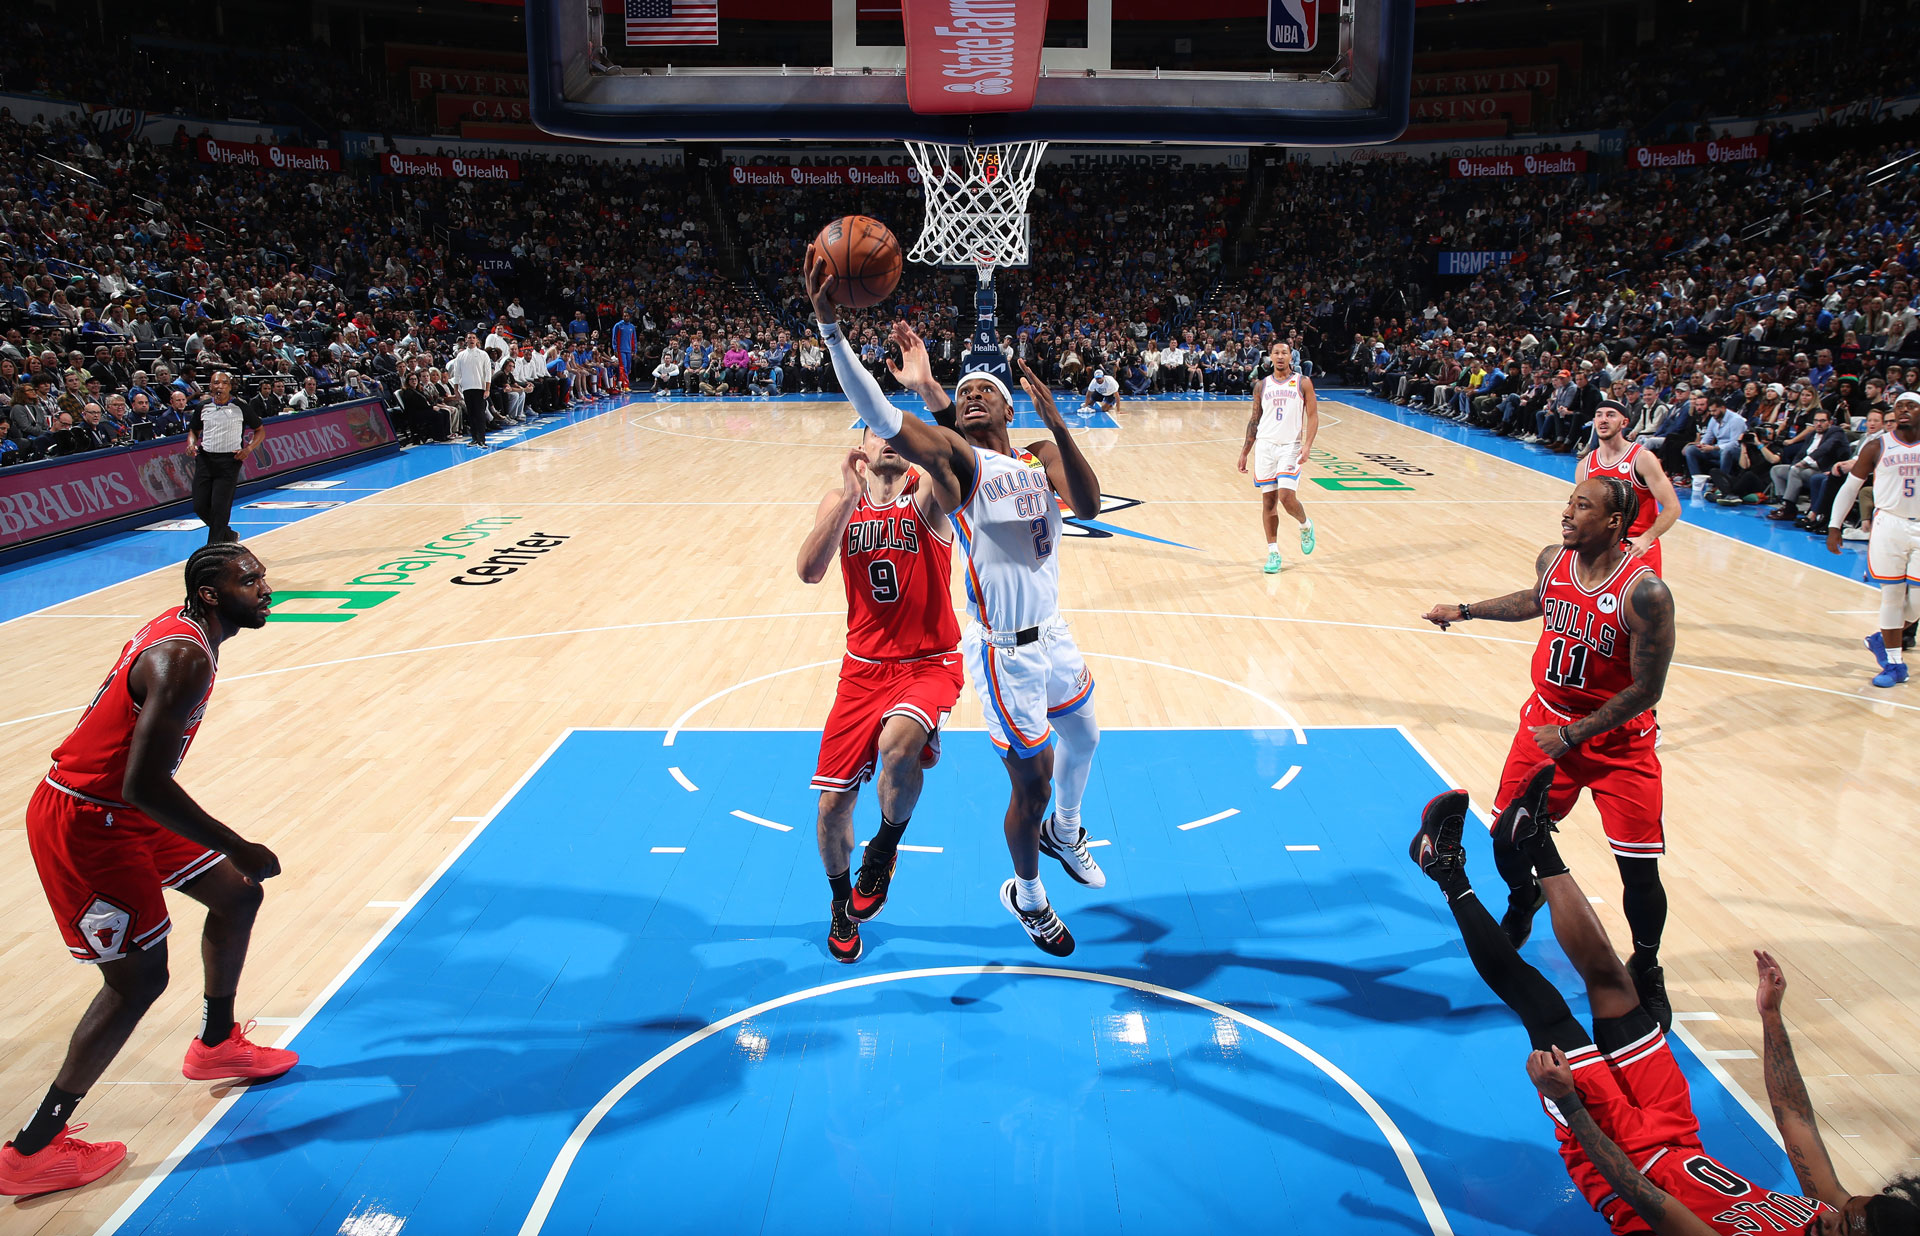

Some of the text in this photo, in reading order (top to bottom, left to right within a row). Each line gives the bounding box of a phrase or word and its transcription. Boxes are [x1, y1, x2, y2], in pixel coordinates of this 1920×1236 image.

[1275, 25, 1299, 44] NBA
[222, 148, 260, 166] Health
[1070, 154, 1183, 168] THUNDER
[1652, 149, 1696, 166] Health
[1719, 143, 1758, 161] Health
[286, 153, 330, 170] Health
[404, 161, 442, 177] Health
[1473, 161, 1514, 176] Health
[1537, 157, 1576, 173] Health
[468, 165, 509, 179] Health
[747, 170, 785, 185] Health
[805, 170, 842, 185] Health
[862, 170, 900, 185] Health
[479, 260, 512, 270] LTRA
[974, 344, 998, 353] Health
[1264, 389, 1298, 401] OKLAHOMA
[1272, 398, 1287, 407] CITY
[1275, 407, 1284, 421] 6
[272, 424, 347, 465] BRAUM'S
[1355, 451, 1435, 477] center
[1903, 477, 1916, 498] 5
[0, 471, 134, 536] BRAUM'S
[1014, 491, 1043, 519] CIT
[847, 517, 920, 557] BULLS
[1030, 515, 1054, 561] 2
[343, 516, 524, 586] paycom
[449, 531, 572, 587] center
[868, 559, 901, 604] 9
[1544, 597, 1618, 658] BULLS
[1545, 637, 1589, 689] 11
[1682, 1154, 1752, 1198] 0
